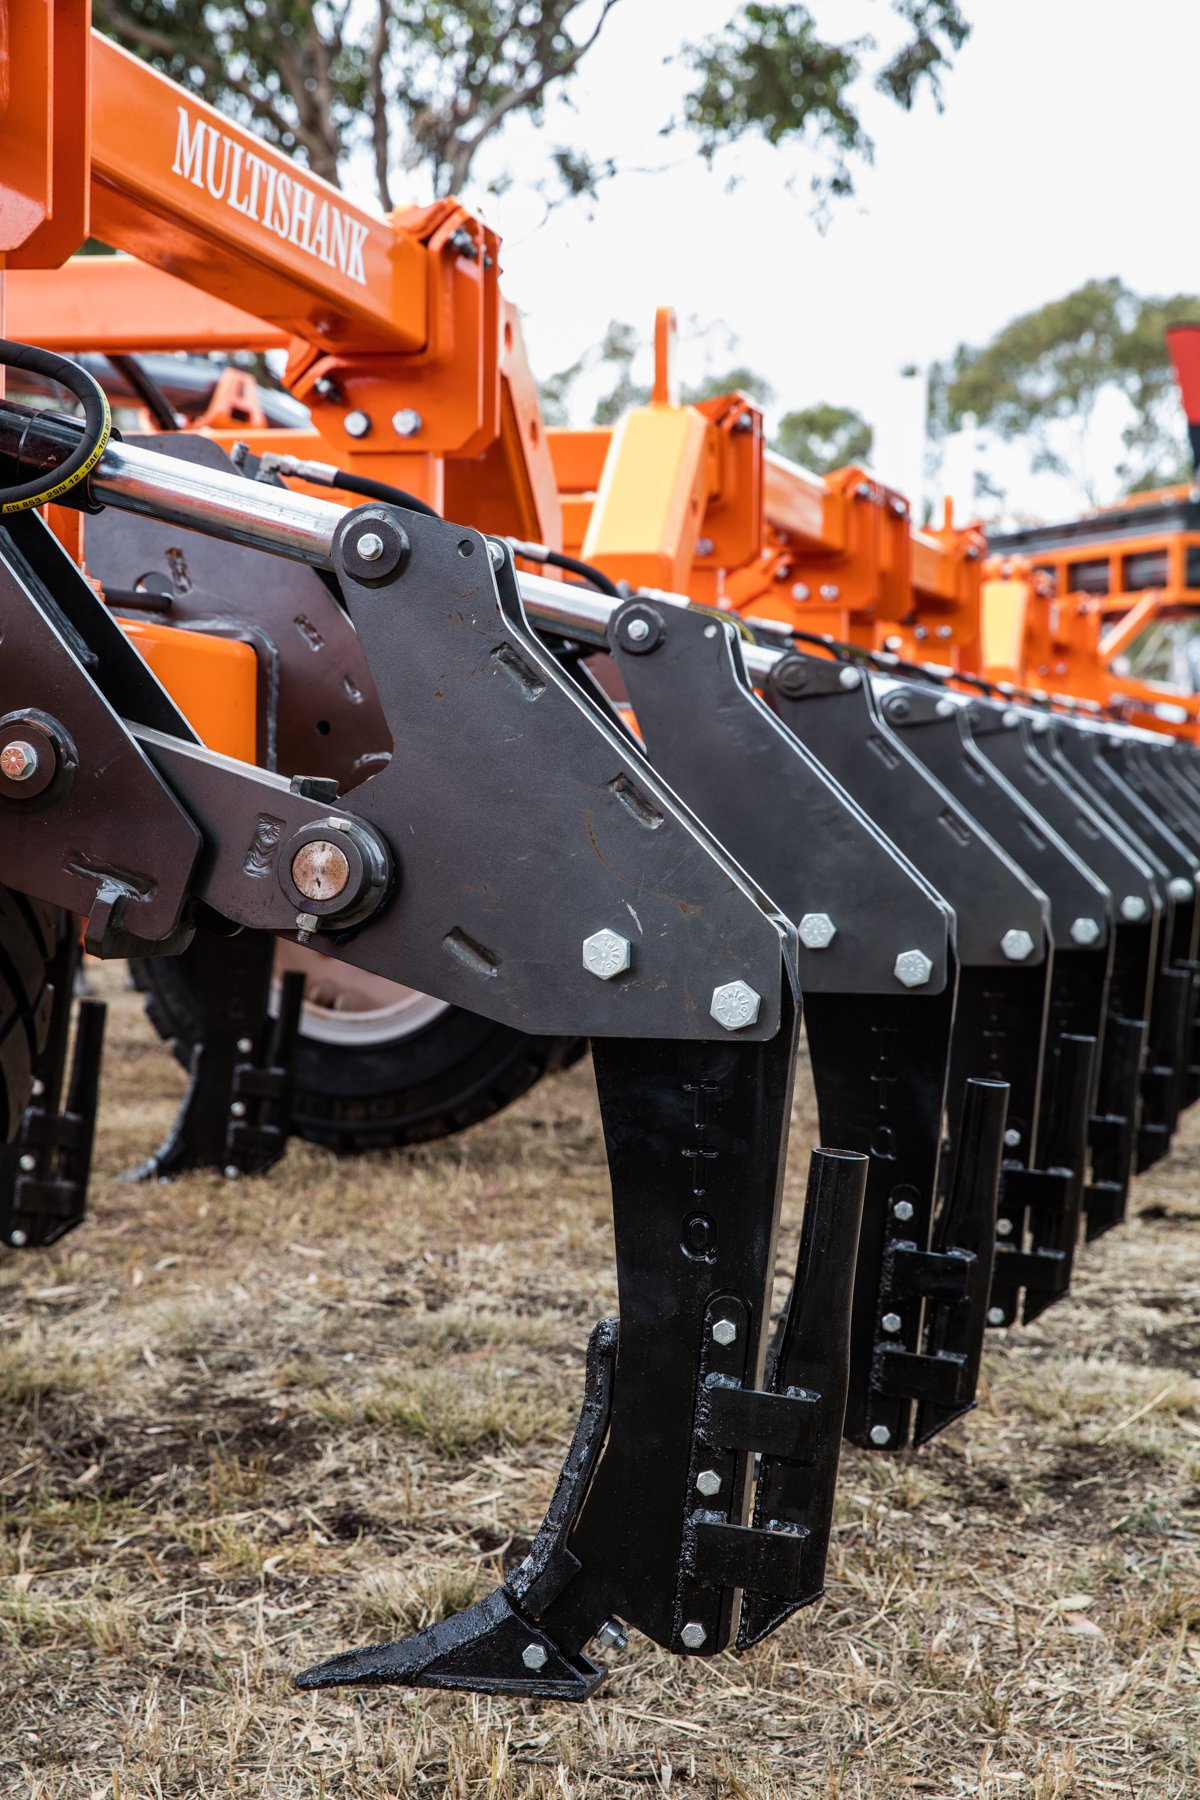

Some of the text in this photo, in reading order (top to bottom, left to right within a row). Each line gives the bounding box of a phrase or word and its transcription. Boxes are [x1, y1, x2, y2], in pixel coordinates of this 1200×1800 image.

[171, 105, 370, 286] MULTISHANK
[46, 484, 67, 499] 2SN
[68, 474, 80, 485] 12
[84, 453, 99, 470] SAE
[98, 432, 108, 450] 100
[680, 1079, 720, 1265] TTQ
